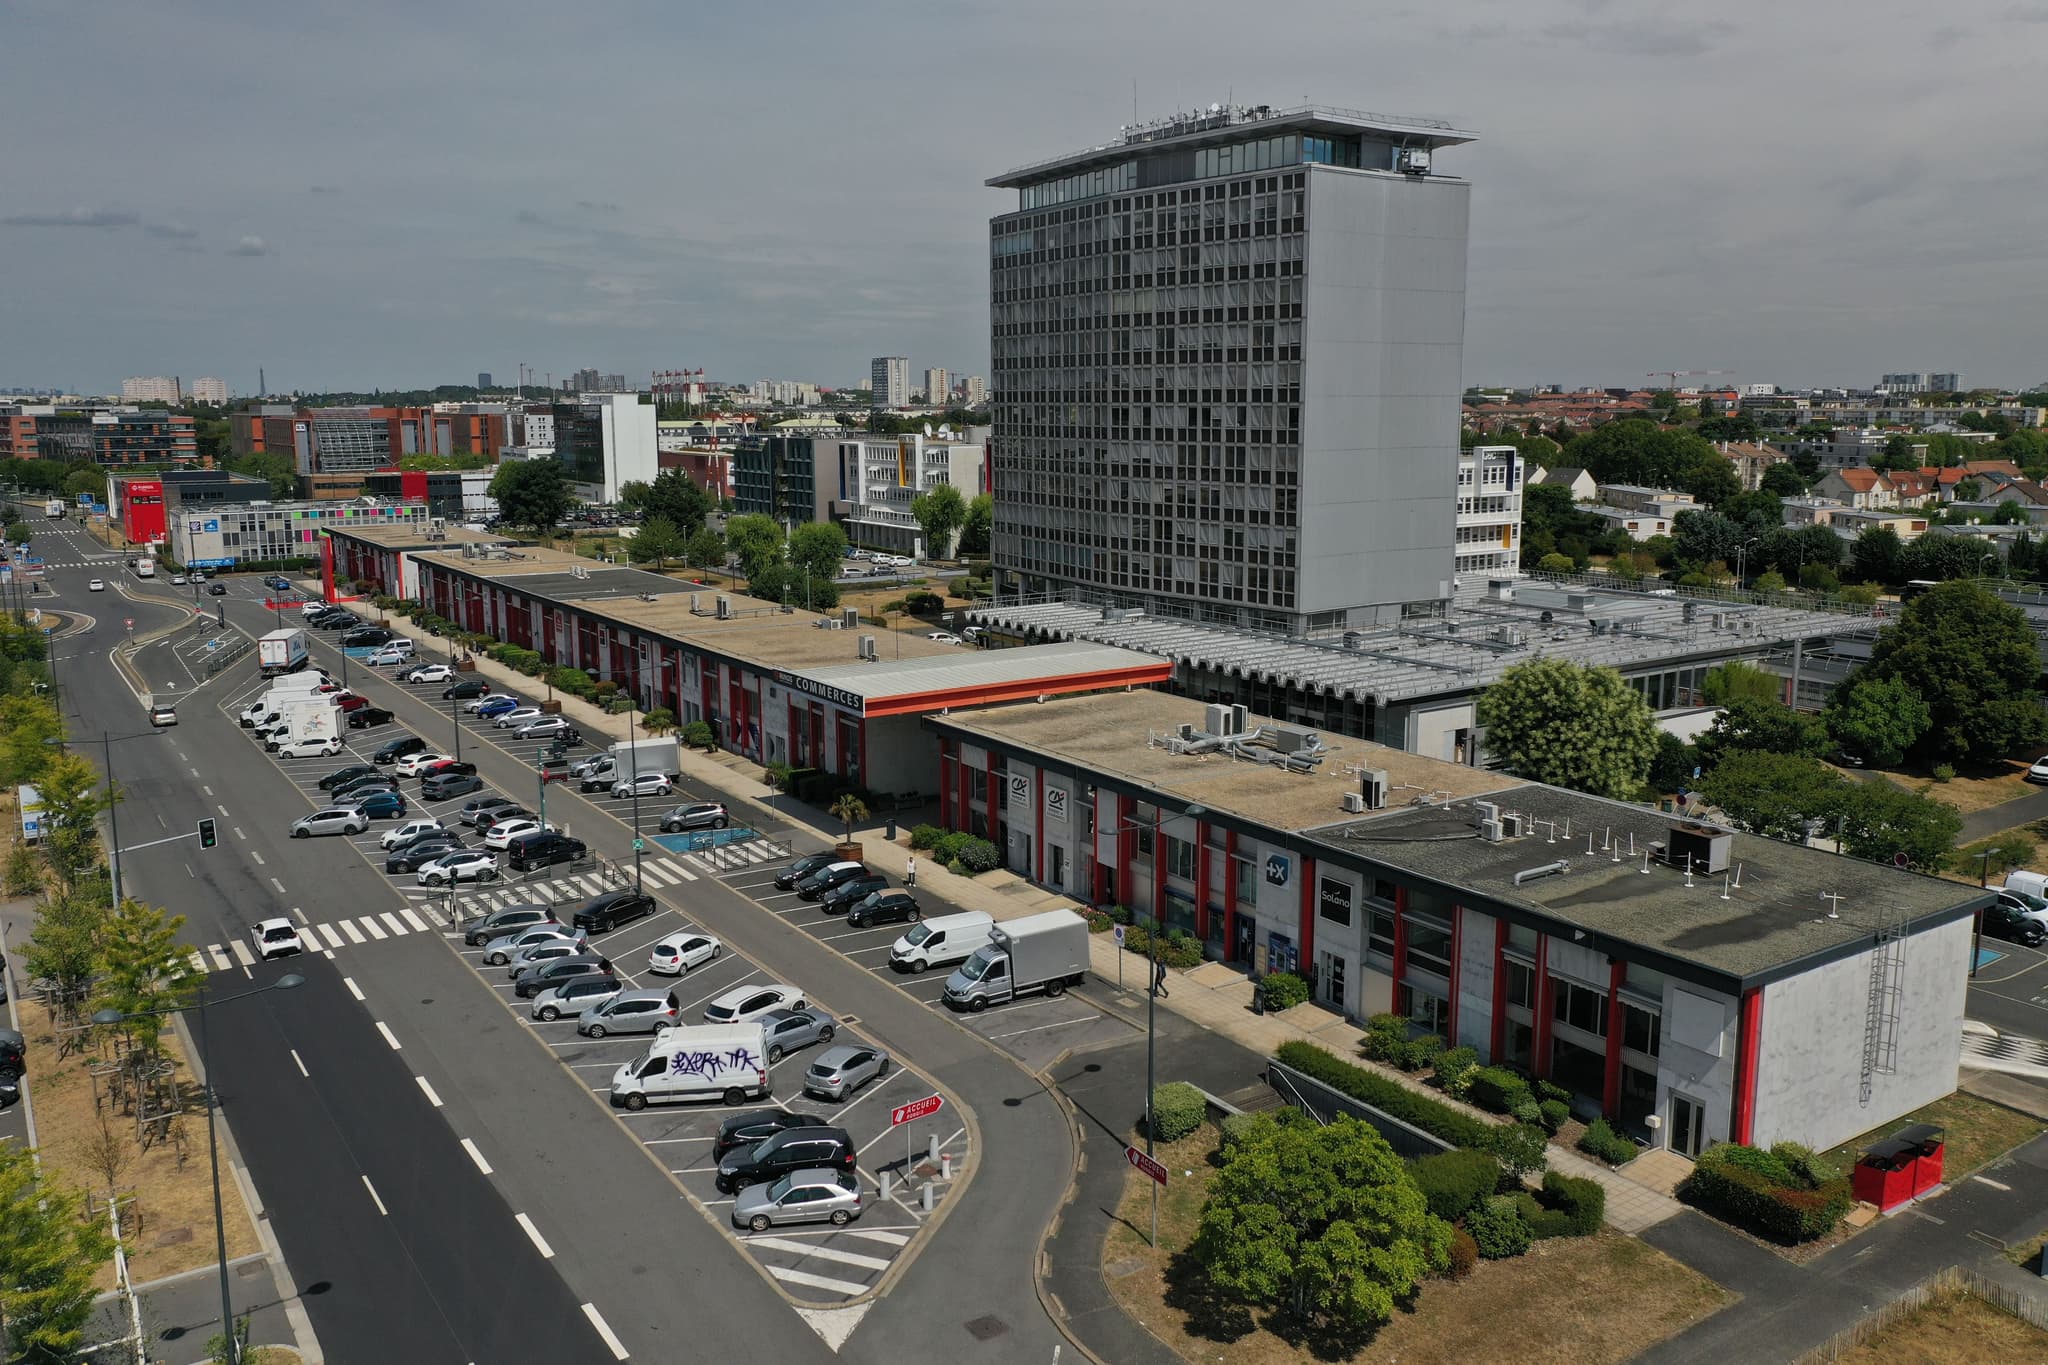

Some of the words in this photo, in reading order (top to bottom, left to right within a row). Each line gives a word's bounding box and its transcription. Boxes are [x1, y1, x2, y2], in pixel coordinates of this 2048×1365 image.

[796, 678, 859, 708] COMMERCES
[1321, 890, 1351, 908] Solano
[907, 1097, 937, 1114] ACCUEIL
[1140, 1156, 1166, 1178] ACCUEIL
